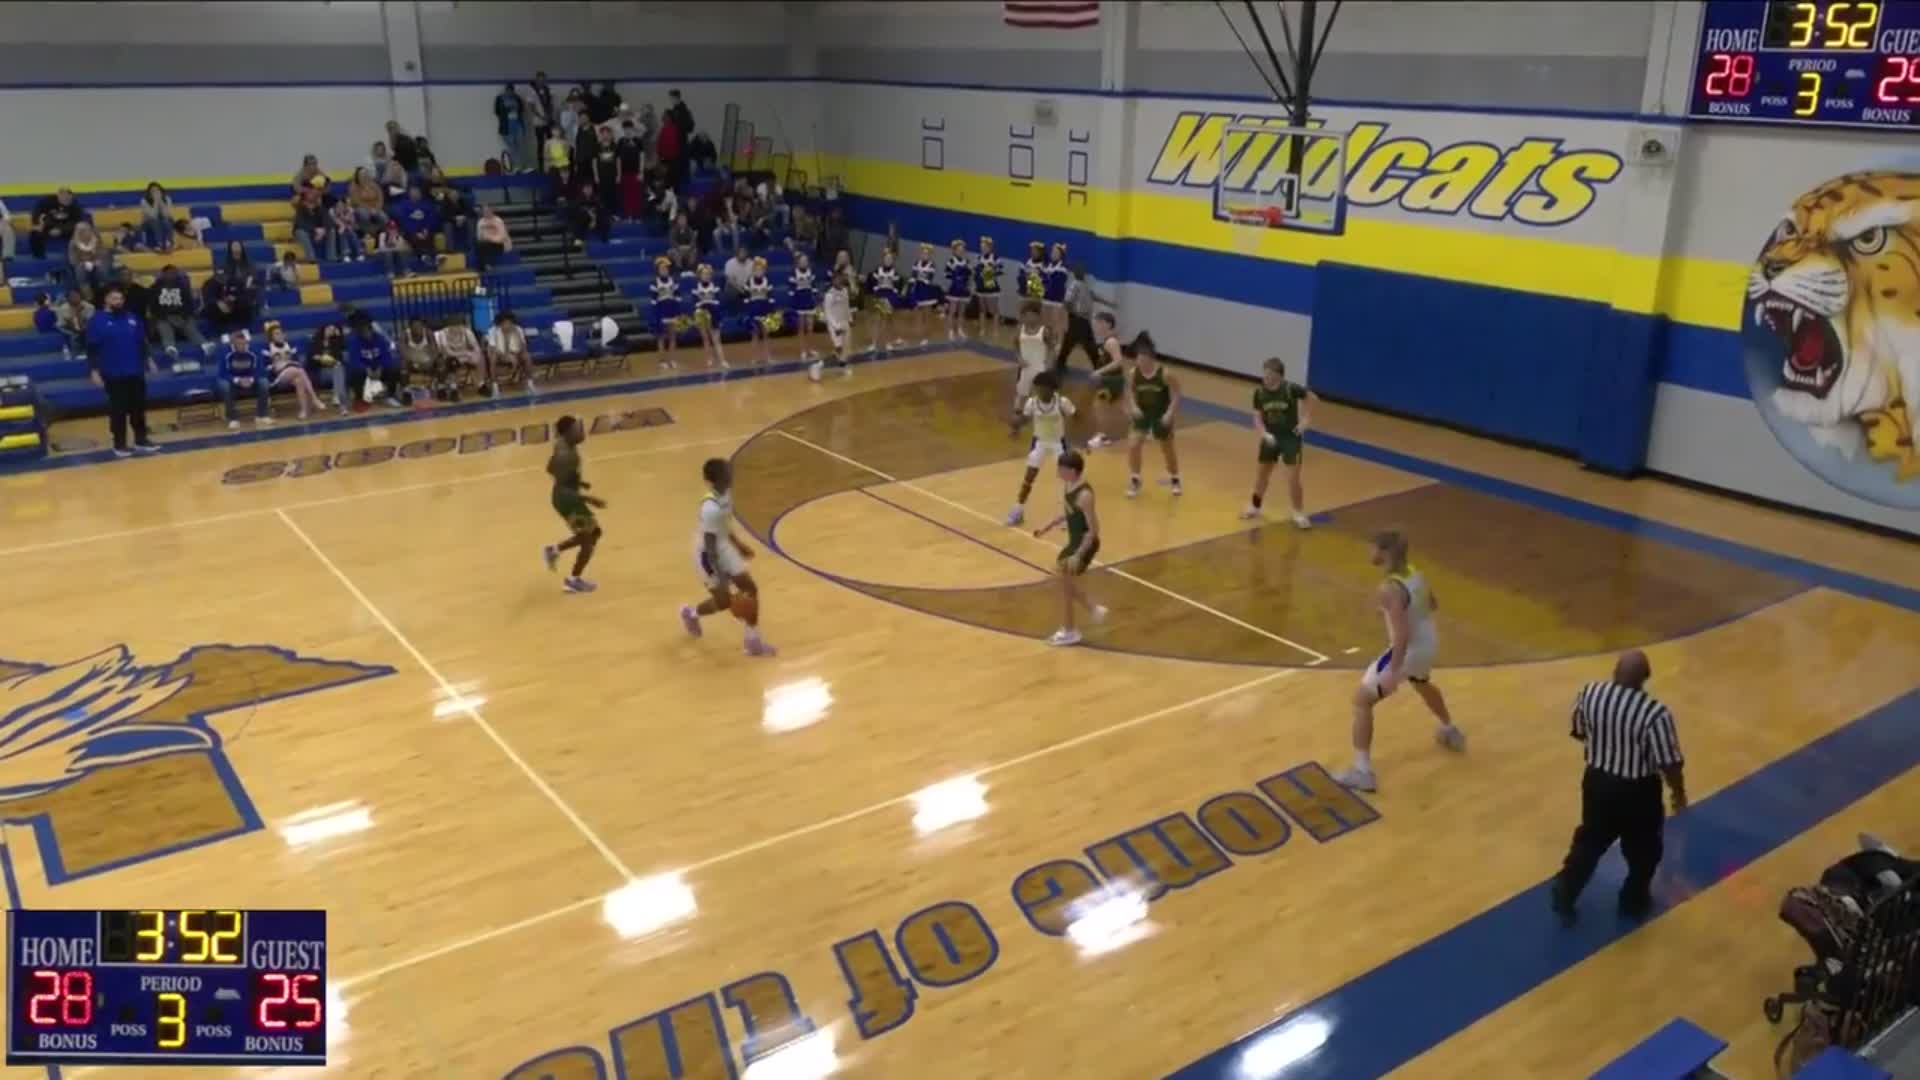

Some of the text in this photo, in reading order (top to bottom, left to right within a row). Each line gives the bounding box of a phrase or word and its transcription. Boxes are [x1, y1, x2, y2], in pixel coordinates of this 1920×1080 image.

[1705, 28, 1761, 51] HOME
[1705, 54, 1754, 96] 28
[1788, 58, 1837, 72] PERIOD
[1761, 95, 1788, 106] POSS
[1794, 72, 1822, 115] 3
[1825, 98, 1854, 109] POSS
[1708, 102, 1752, 115] BONUS
[1862, 107, 1912, 122] BONUS
[1147, 112, 1625, 227] Wildcats
[1011, 761, 1383, 937] Home
[832, 900, 1000, 1040] of
